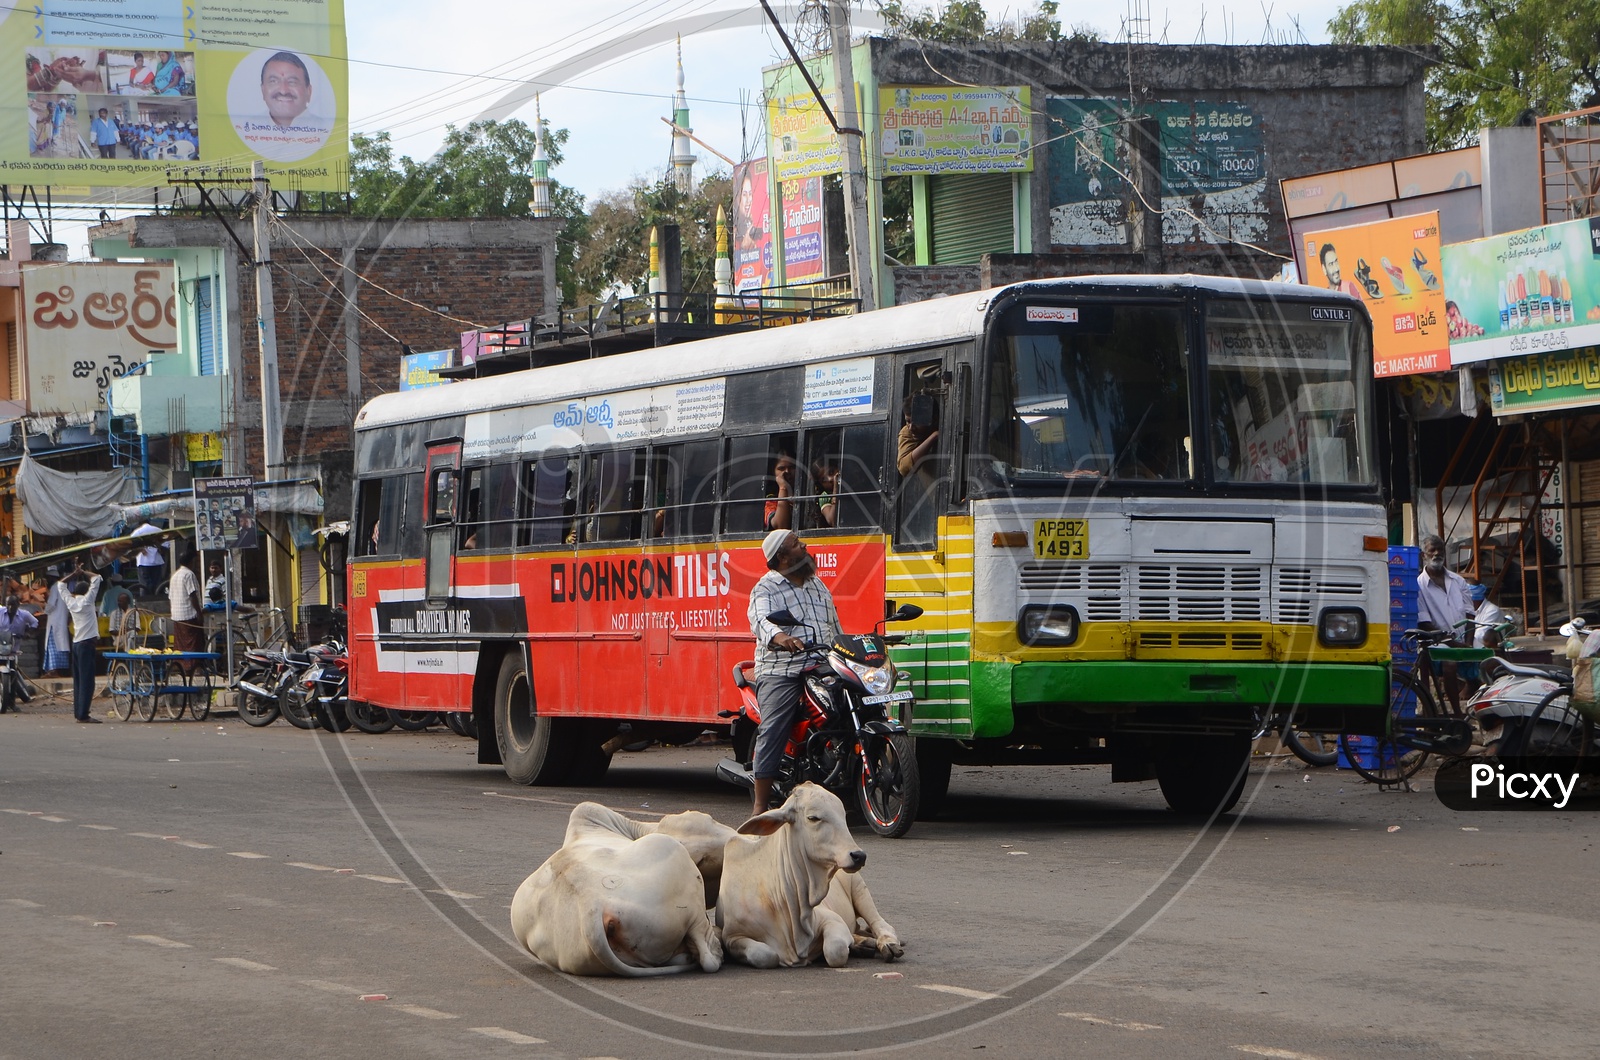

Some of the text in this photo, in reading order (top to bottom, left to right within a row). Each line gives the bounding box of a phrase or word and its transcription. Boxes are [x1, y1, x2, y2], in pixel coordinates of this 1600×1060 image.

[883, 108, 897, 129] శ్రీ
[901, 108, 943, 129] వీరభద్ర
[948, 107, 969, 125] A-1
[899, 149, 918, 157] L.K.G.
[9, 162, 31, 170] భవన
[33, 162, 65, 170] మరియు
[67, 163, 88, 171] ఇతర
[1028, 309, 1065, 320] గుంటూరు
[1313, 308, 1344, 320] GUNTUR
[1389, 354, 1438, 372] MART-AMT
[553, 403, 583, 428] ఆమ్
[586, 399, 614, 429] ఆద్మీ
[1038, 521, 1084, 537] AP29Z
[1037, 540, 1083, 557] 1493
[353, 582, 366, 596] 1493
[416, 610, 447, 633] BEAUTIFUL
[447, 609, 471, 634] HOMES
[611, 612, 629, 630] NOT
[630, 611, 650, 630] JUST
[651, 610, 680, 631] TILES,
